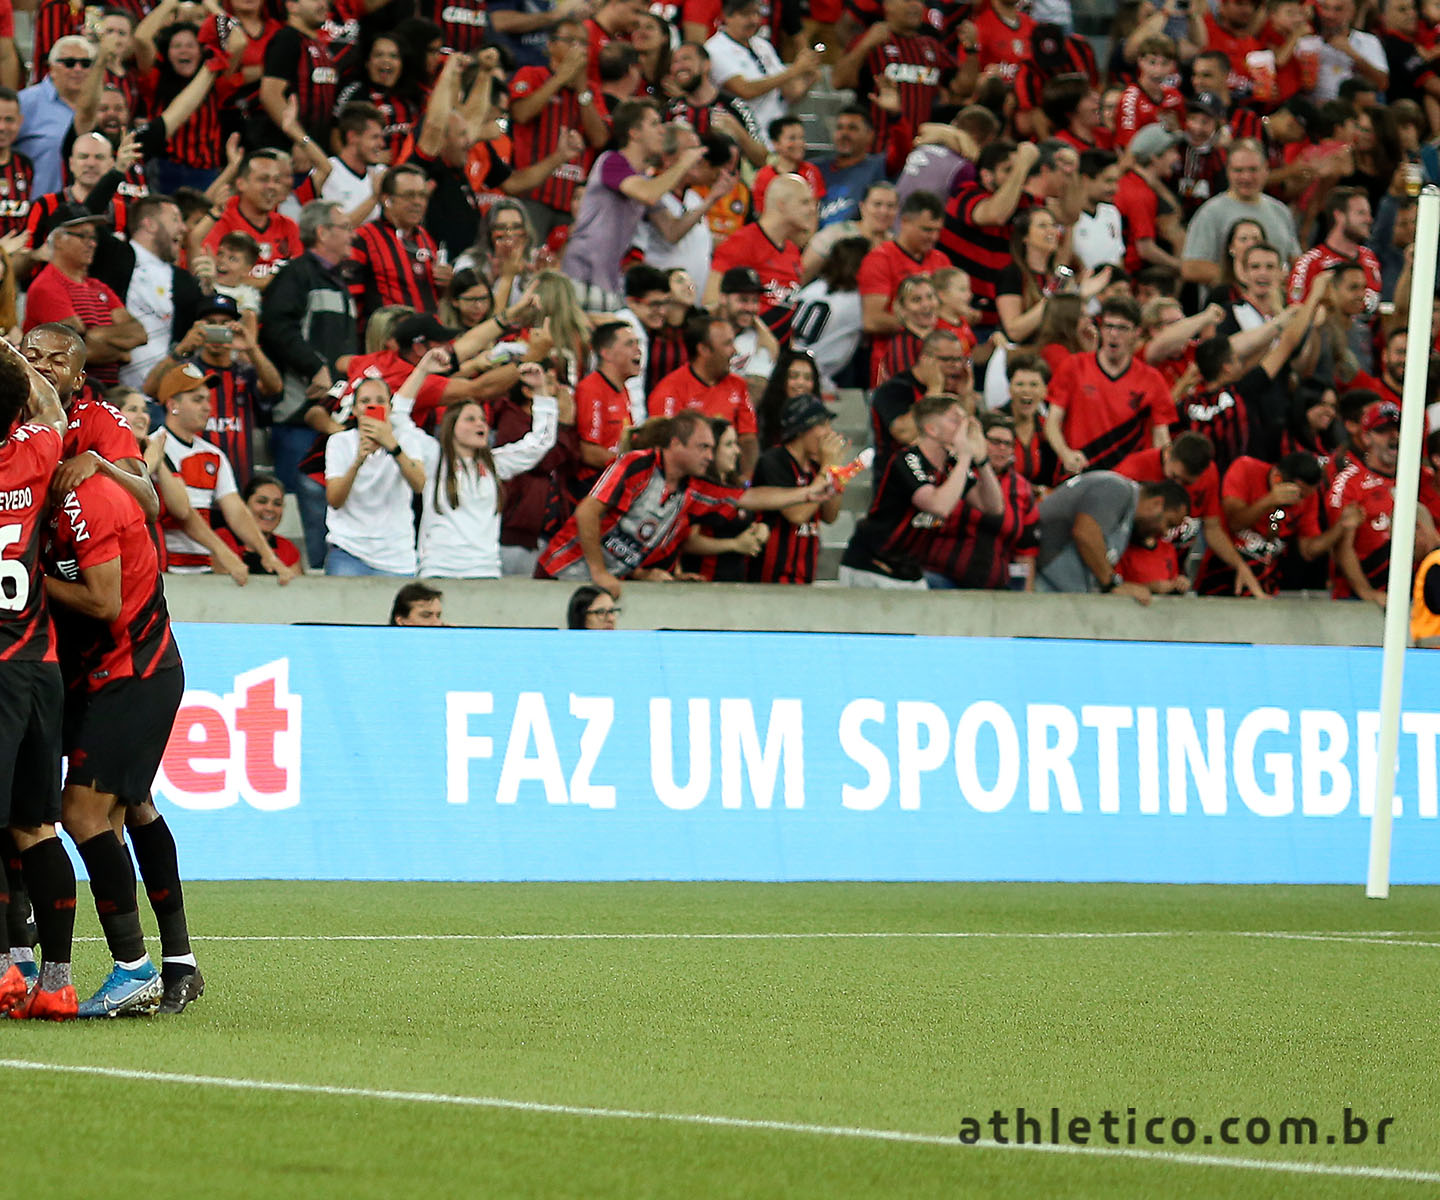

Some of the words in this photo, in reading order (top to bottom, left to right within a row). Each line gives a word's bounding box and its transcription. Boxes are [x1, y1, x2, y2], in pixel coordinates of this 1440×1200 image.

[205, 416, 242, 432] AIXA
[445, 690, 617, 810] FAZ
[649, 697, 806, 811] UM
